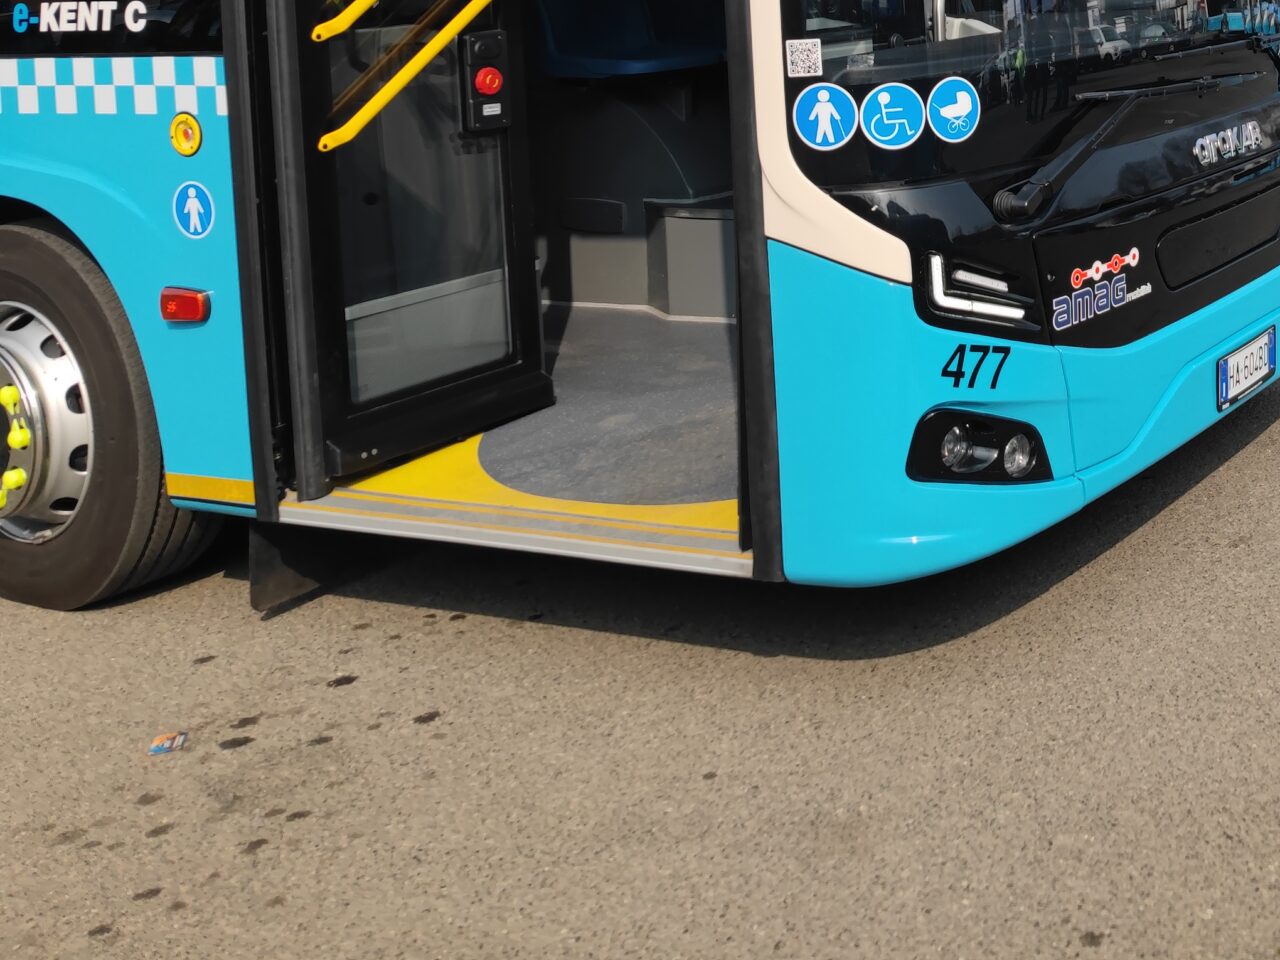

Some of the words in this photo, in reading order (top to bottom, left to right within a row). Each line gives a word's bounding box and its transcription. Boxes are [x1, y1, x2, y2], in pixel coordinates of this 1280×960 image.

[12, 0, 118, 33] e-KENT
[124, 0, 148, 33] C
[1194, 121, 1262, 167] OTOKAR
[941, 344, 1011, 390] 477
